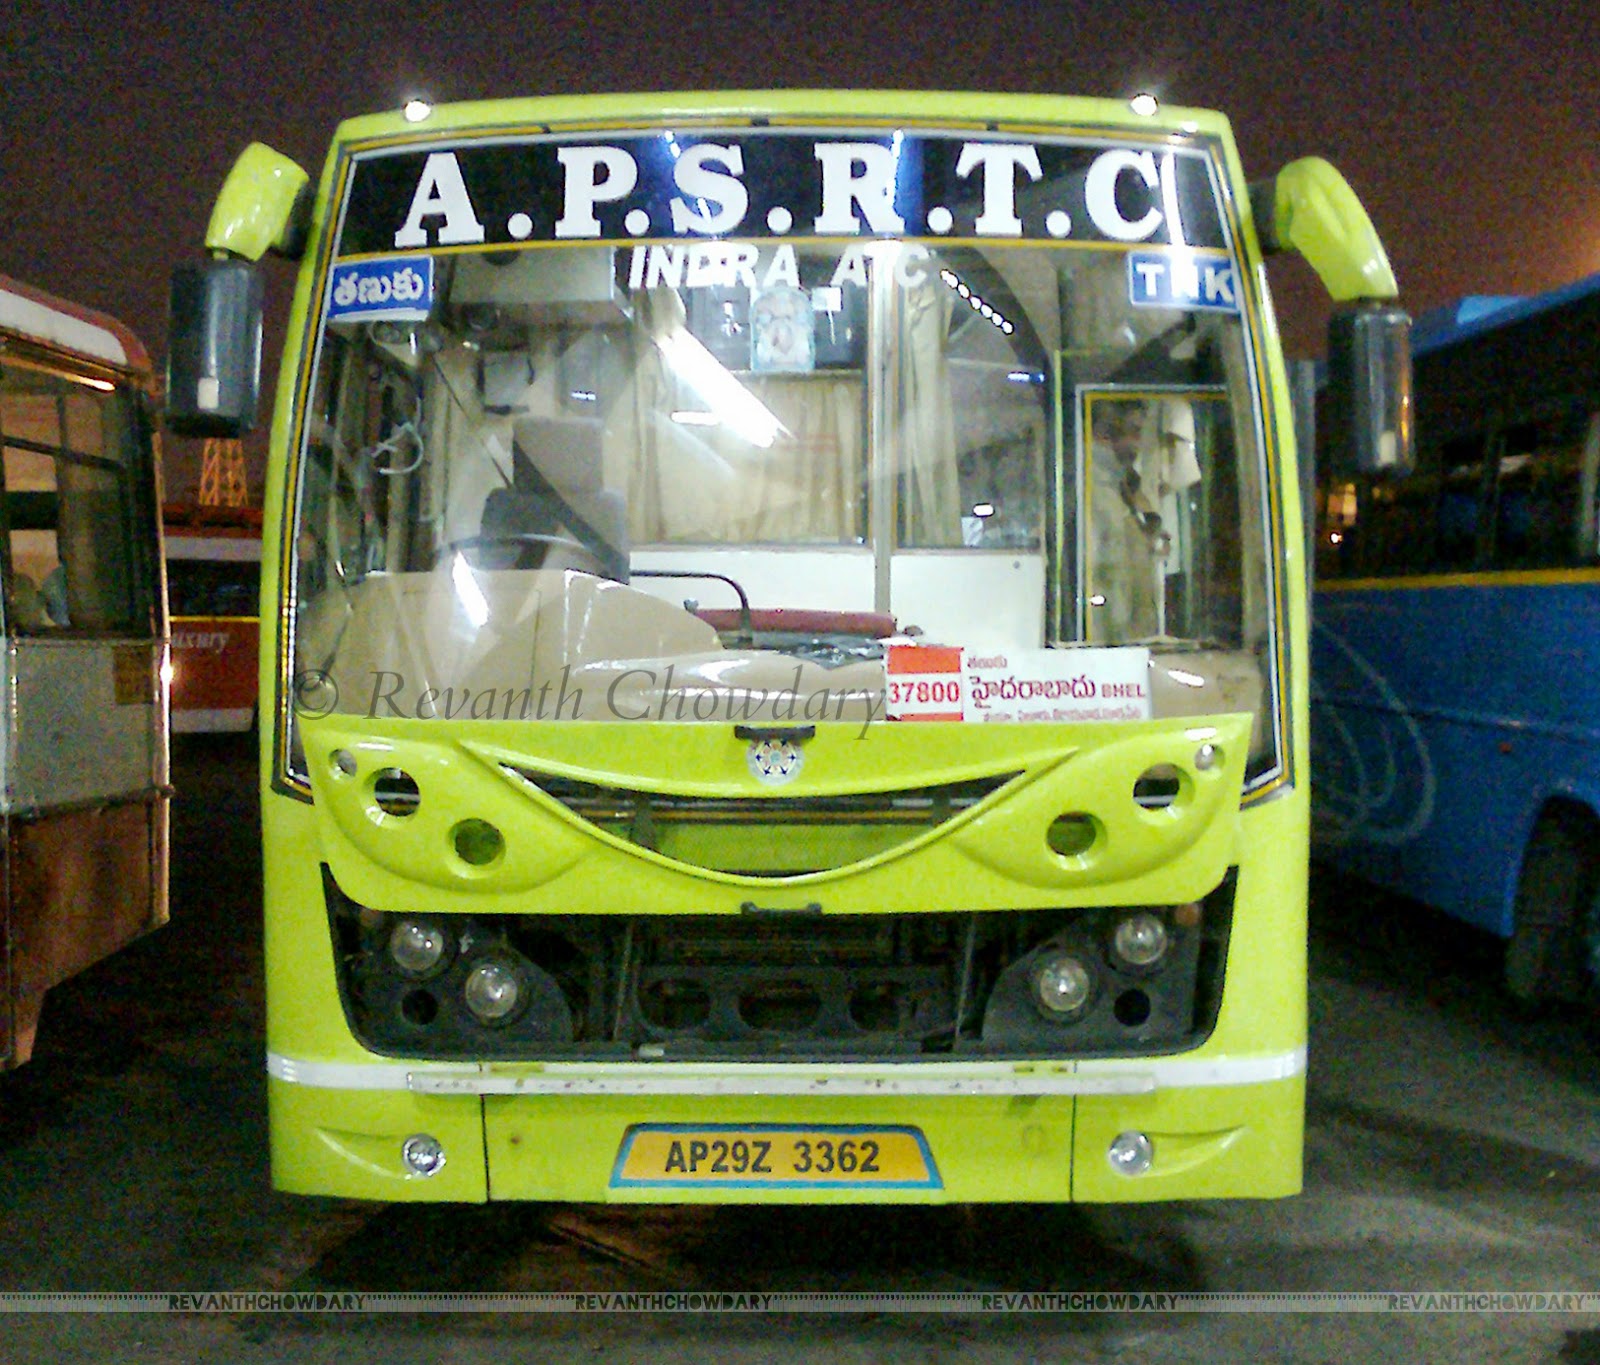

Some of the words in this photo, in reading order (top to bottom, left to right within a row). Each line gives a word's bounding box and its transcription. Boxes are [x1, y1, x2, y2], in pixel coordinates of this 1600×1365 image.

[394, 142, 1164, 248] A.P.S.R.T.C
[628, 243, 801, 288] INDRA
[171, 632, 229, 653] uxury
[888, 681, 960, 703] 37800
[968, 675, 1096, 708] హైదరాబాదు
[1101, 683, 1146, 698] BHEL
[665, 1141, 772, 1173] AP29Z
[793, 1140, 880, 1173] 3362
